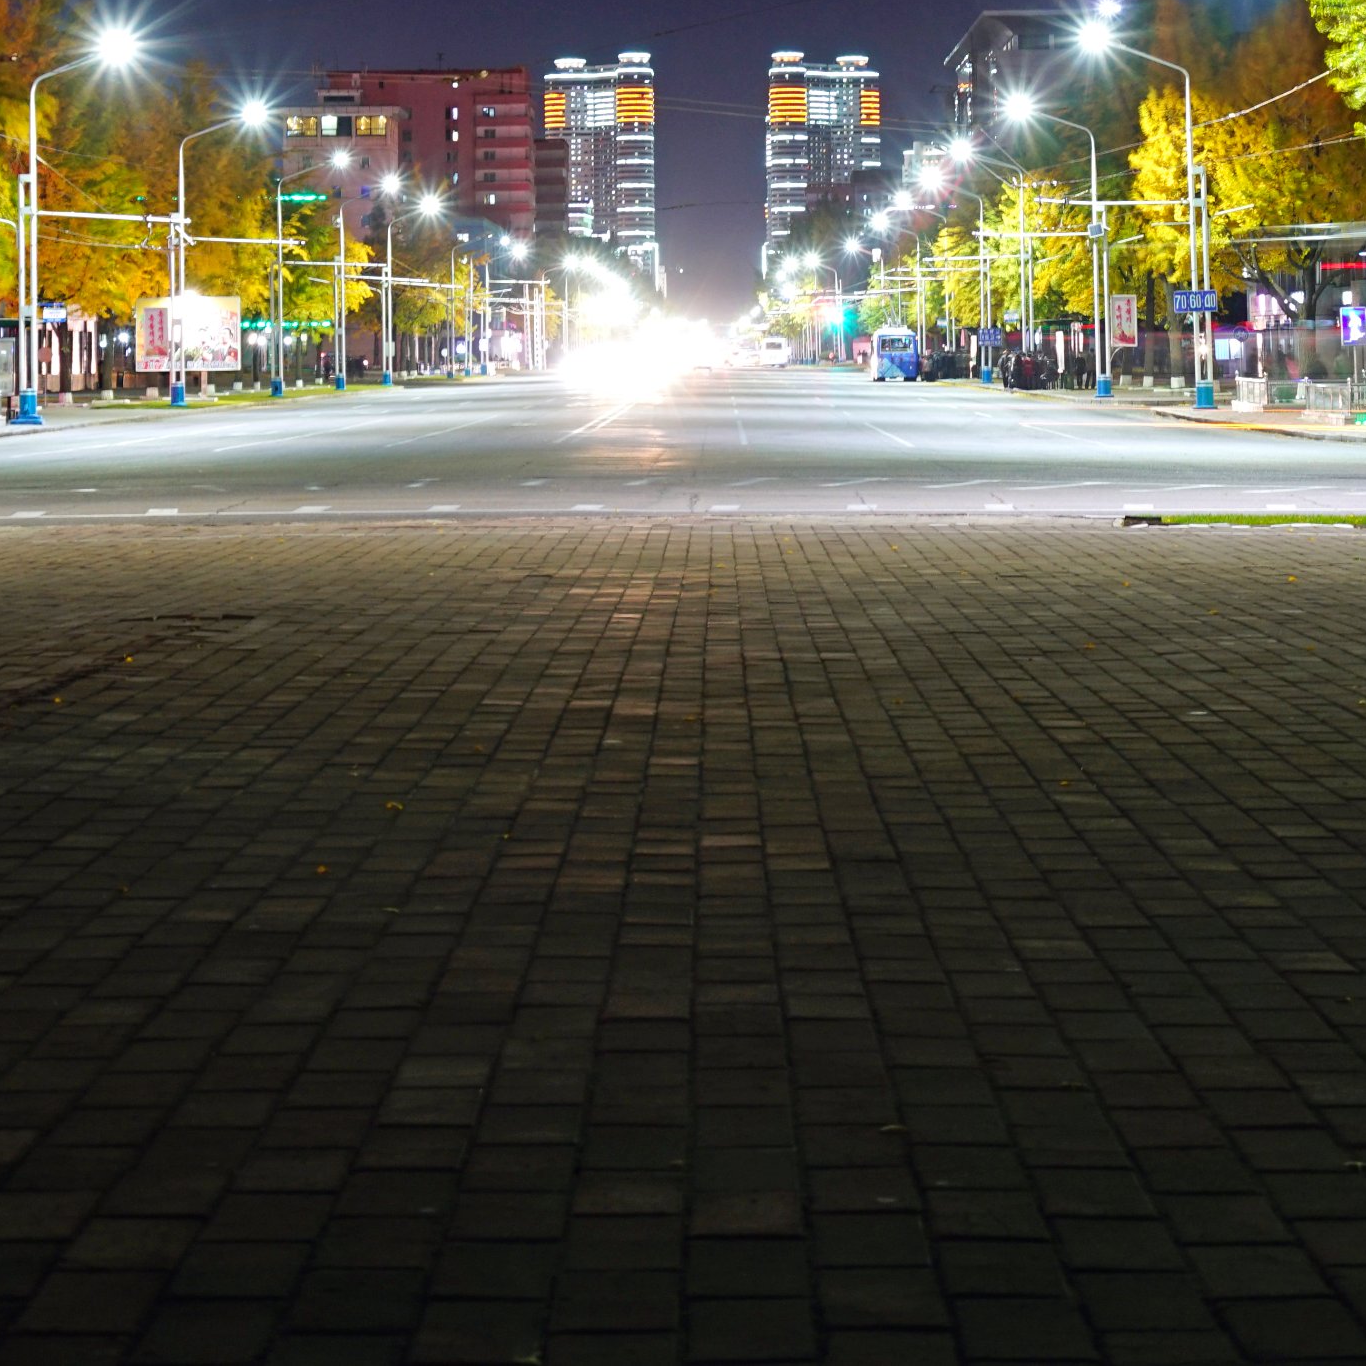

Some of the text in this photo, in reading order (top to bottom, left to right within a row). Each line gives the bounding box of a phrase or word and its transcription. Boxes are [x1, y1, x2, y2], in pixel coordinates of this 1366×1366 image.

[1175, 293, 1216, 309] 70 60 40
